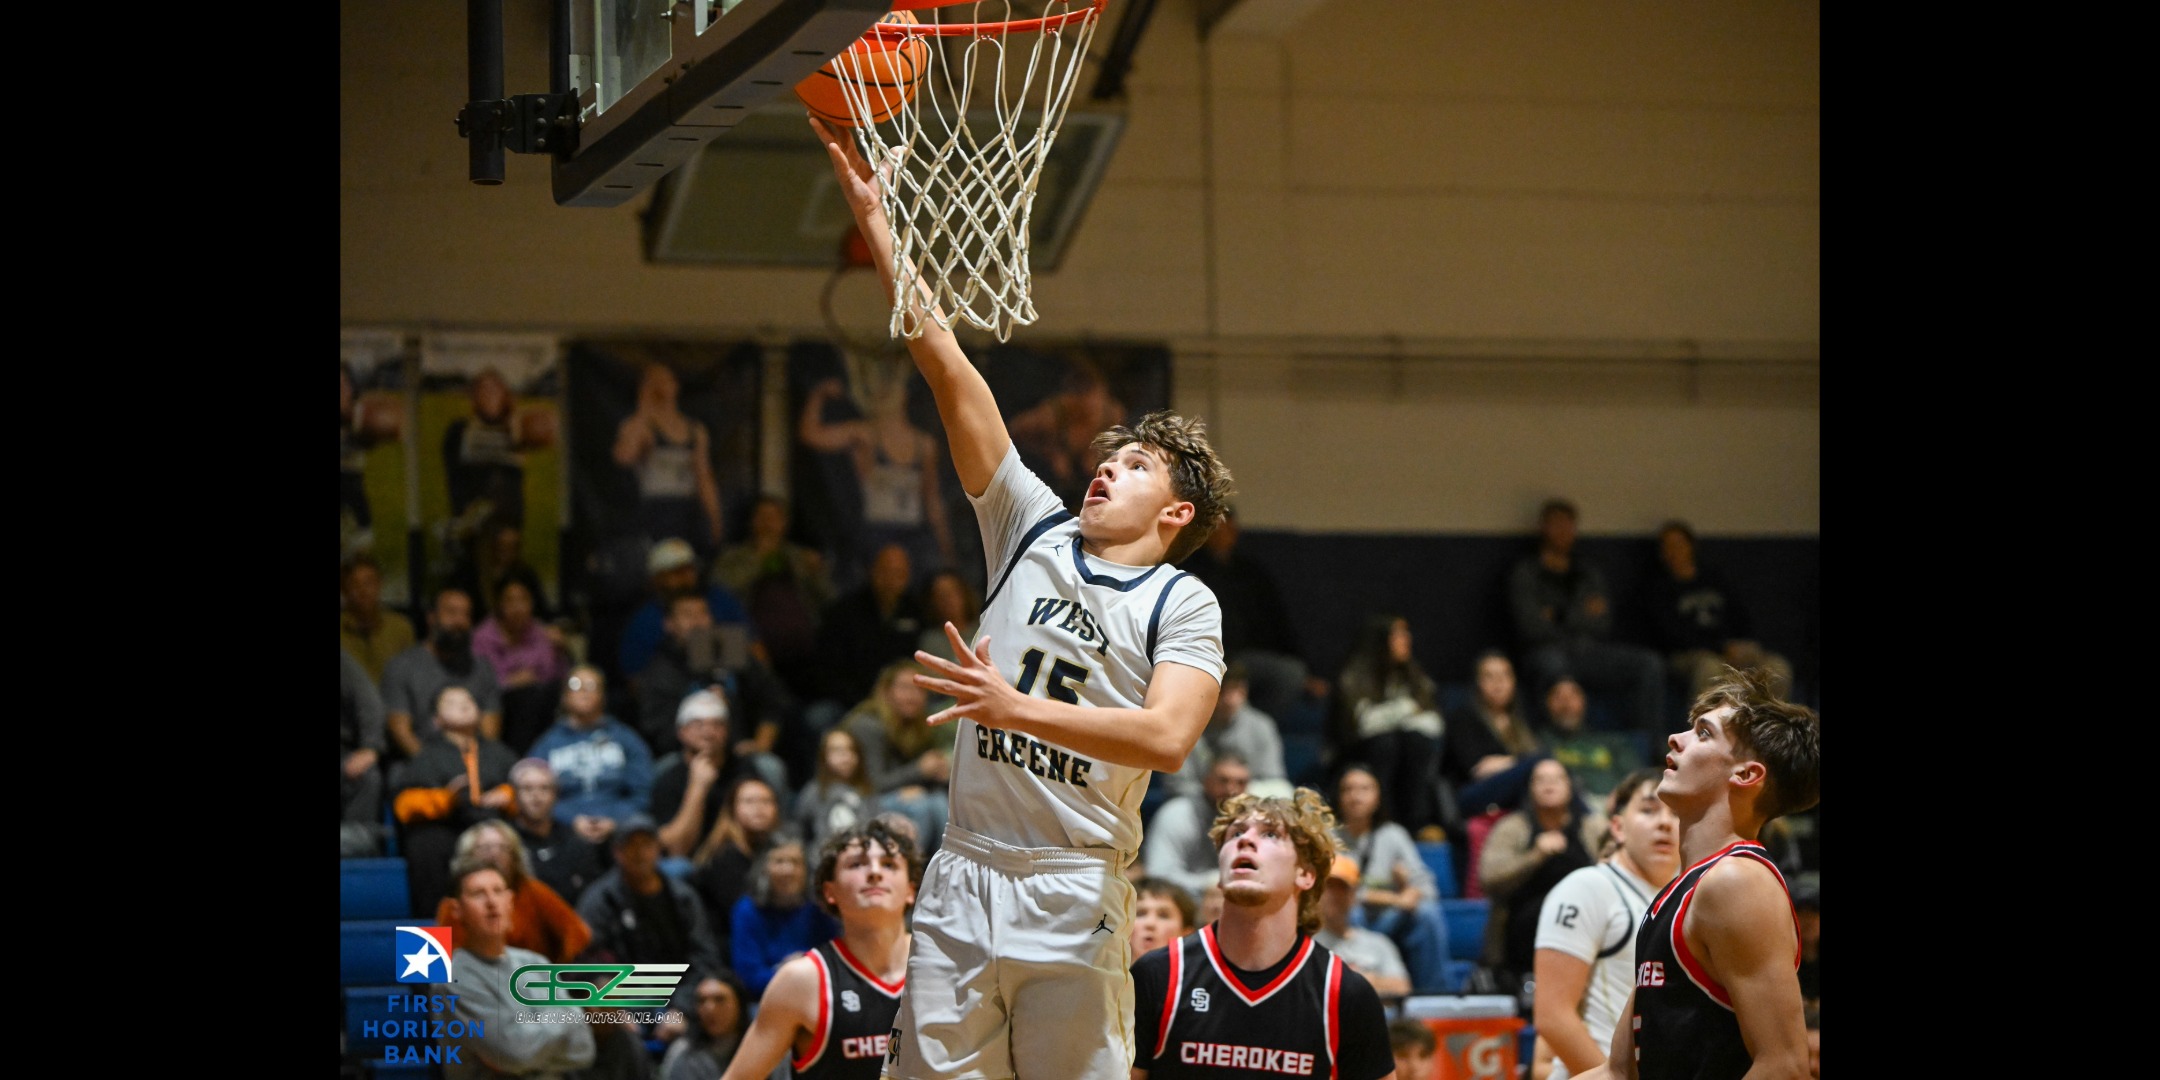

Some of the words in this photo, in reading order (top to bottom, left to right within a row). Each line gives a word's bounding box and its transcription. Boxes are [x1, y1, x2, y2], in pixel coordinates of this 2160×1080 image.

[1027, 597, 1110, 657] WEST
[1014, 645, 1092, 705] 15
[975, 723, 1092, 788] GREENE
[1556, 903, 1579, 929] 12
[842, 1034, 890, 1059] CHE
[1180, 1042, 1315, 1076] CHEROKEE
